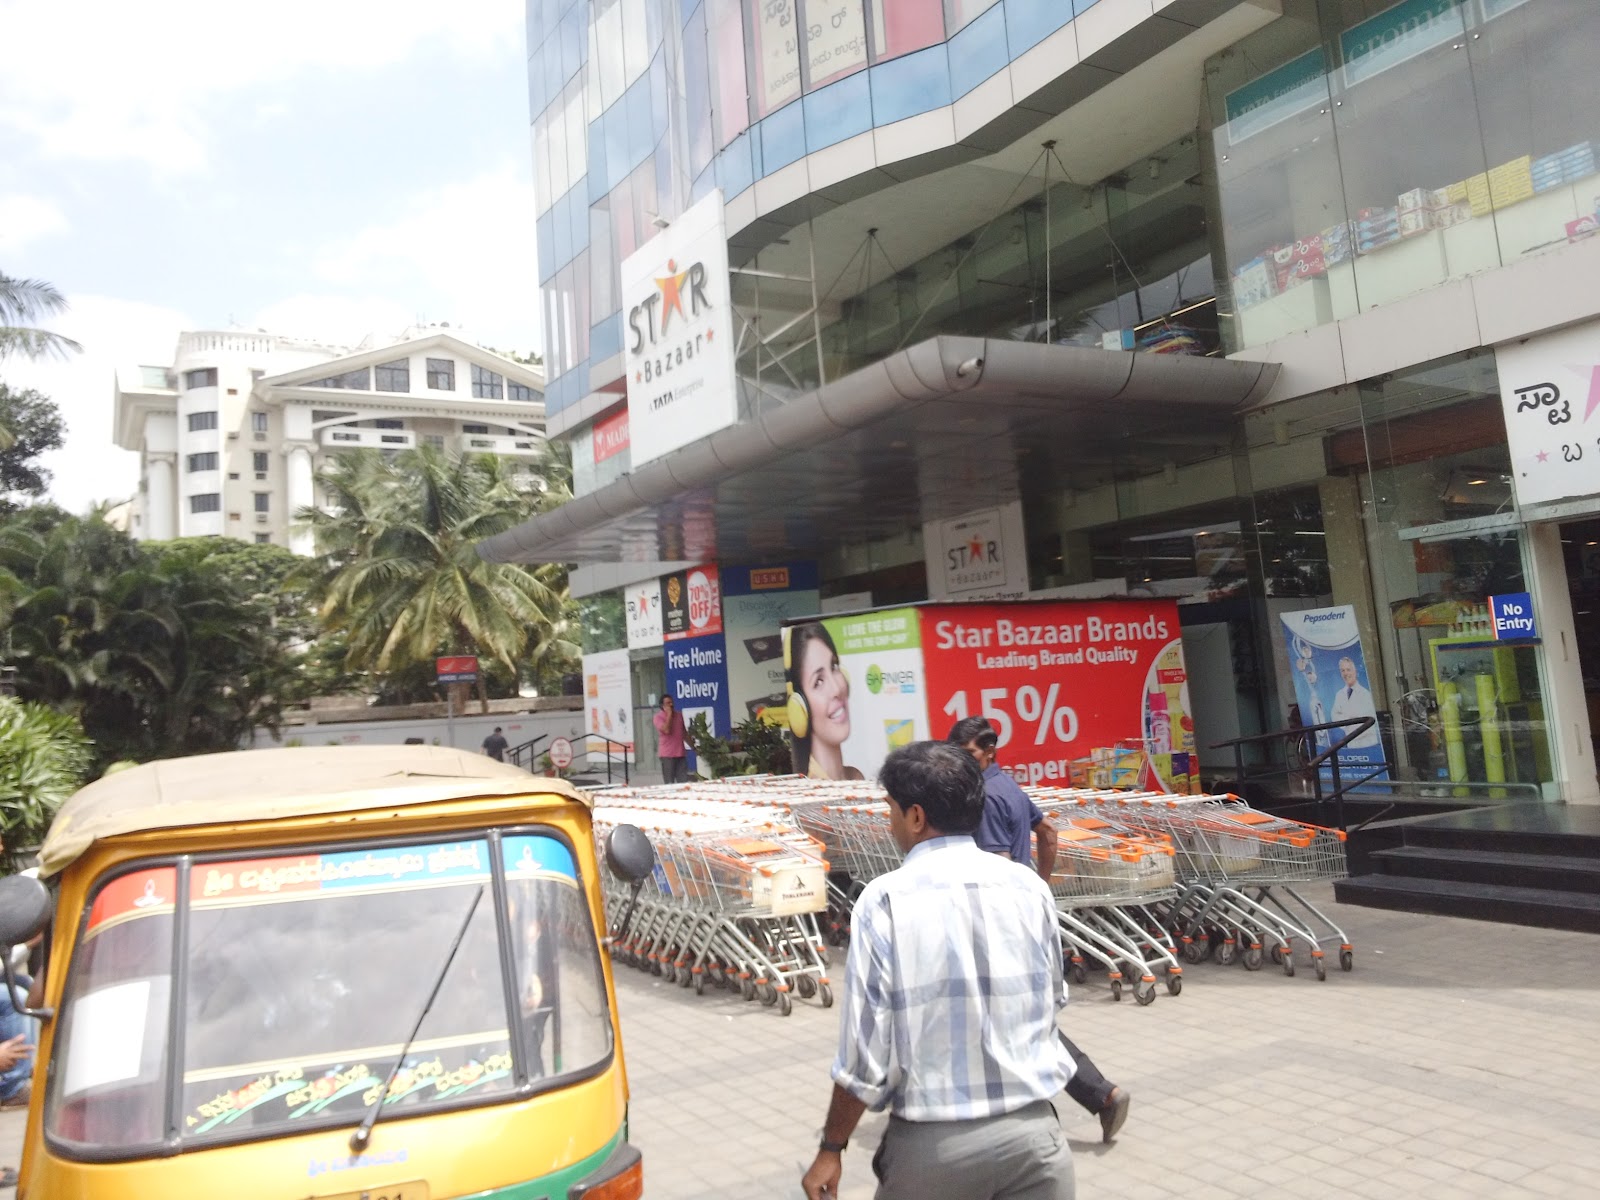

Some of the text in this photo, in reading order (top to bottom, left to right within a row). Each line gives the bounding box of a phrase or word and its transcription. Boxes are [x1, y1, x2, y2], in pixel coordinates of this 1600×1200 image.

[629, 259, 713, 355] STAR
[644, 333, 703, 383] Bazaar
[653, 390, 674, 411] TATA
[948, 534, 998, 570] STAR
[754, 573, 786, 584] USHA
[689, 586, 709, 602] 70%
[691, 600, 709, 620] OFF
[1303, 612, 1346, 624] Pepsodent
[1503, 603, 1523, 616] No
[936, 620, 992, 649] Star
[996, 619, 1083, 645] Bazaar
[1086, 615, 1168, 642] Brands
[1497, 617, 1533, 631] Entry
[668, 647, 722, 669] Free Home
[977, 646, 1138, 670] Leading Brand Quality
[866, 670, 914, 686] GARNIER
[676, 679, 719, 701] Delivery
[943, 683, 1079, 749] 15%
